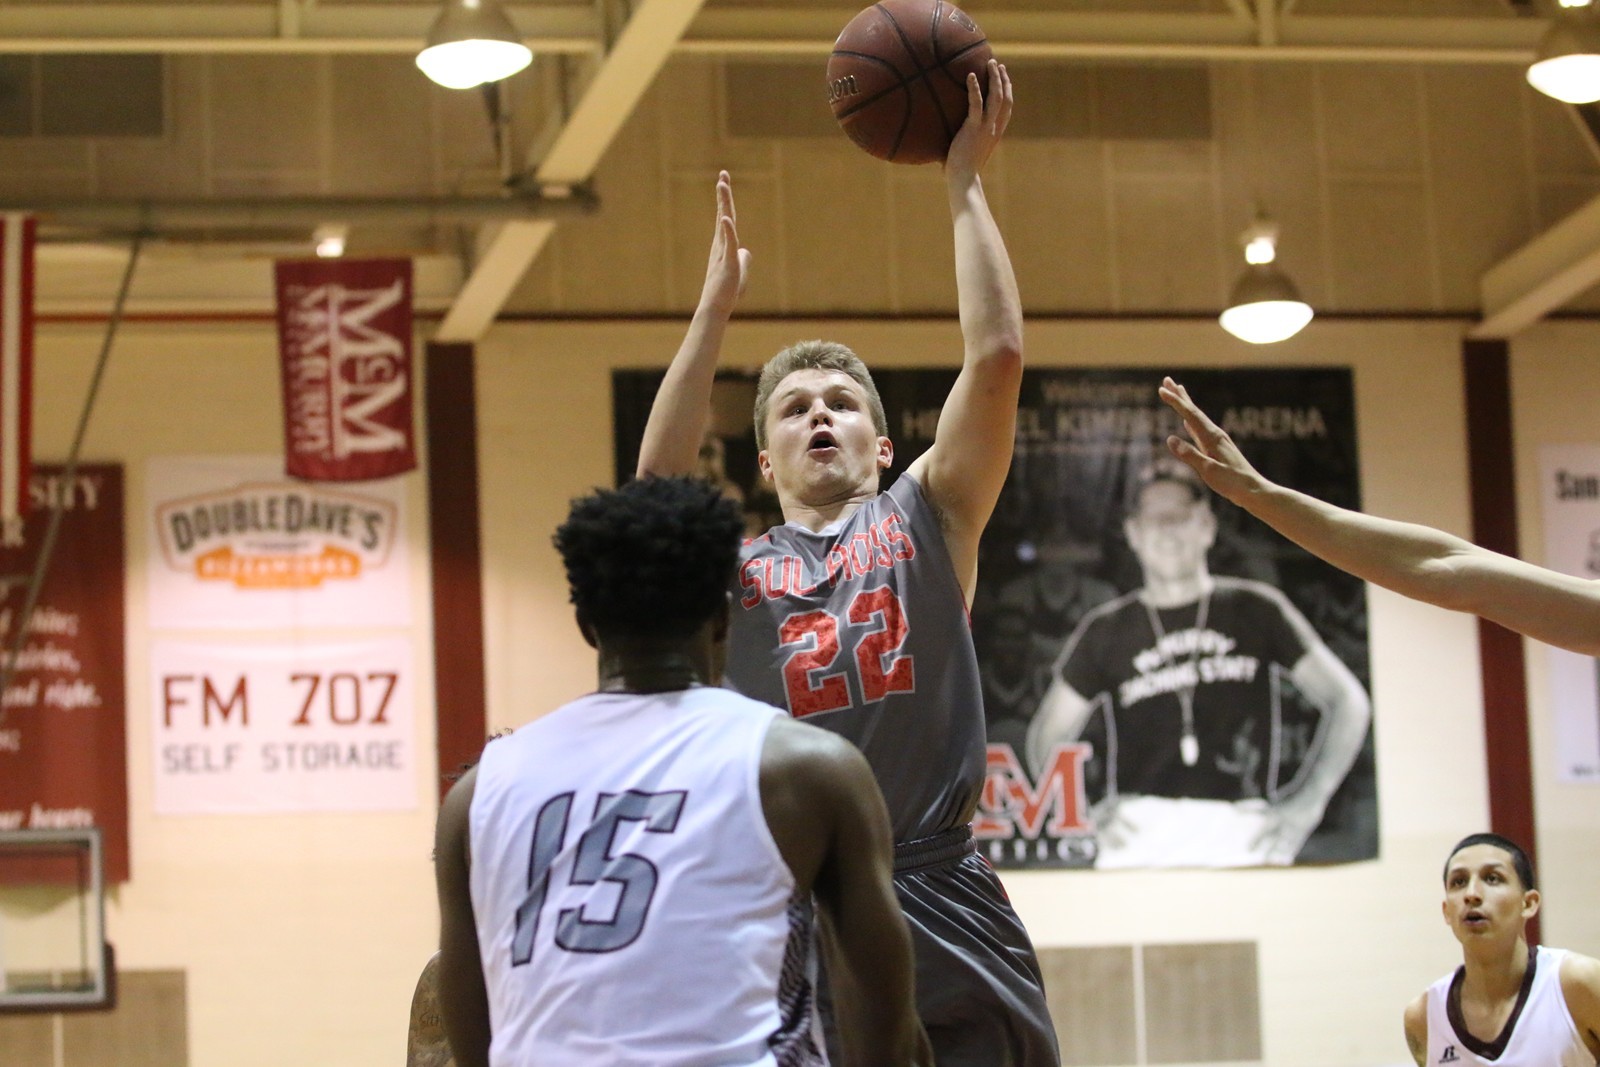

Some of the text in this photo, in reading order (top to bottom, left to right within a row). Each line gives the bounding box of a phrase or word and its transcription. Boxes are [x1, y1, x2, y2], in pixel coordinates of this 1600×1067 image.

[1223, 408, 1326, 438] ARENA
[739, 555, 817, 610] SUL
[777, 583, 916, 718] 22
[162, 673, 400, 728] FM 707
[163, 741, 404, 774] SELF STORAGE
[512, 790, 689, 967] 15
